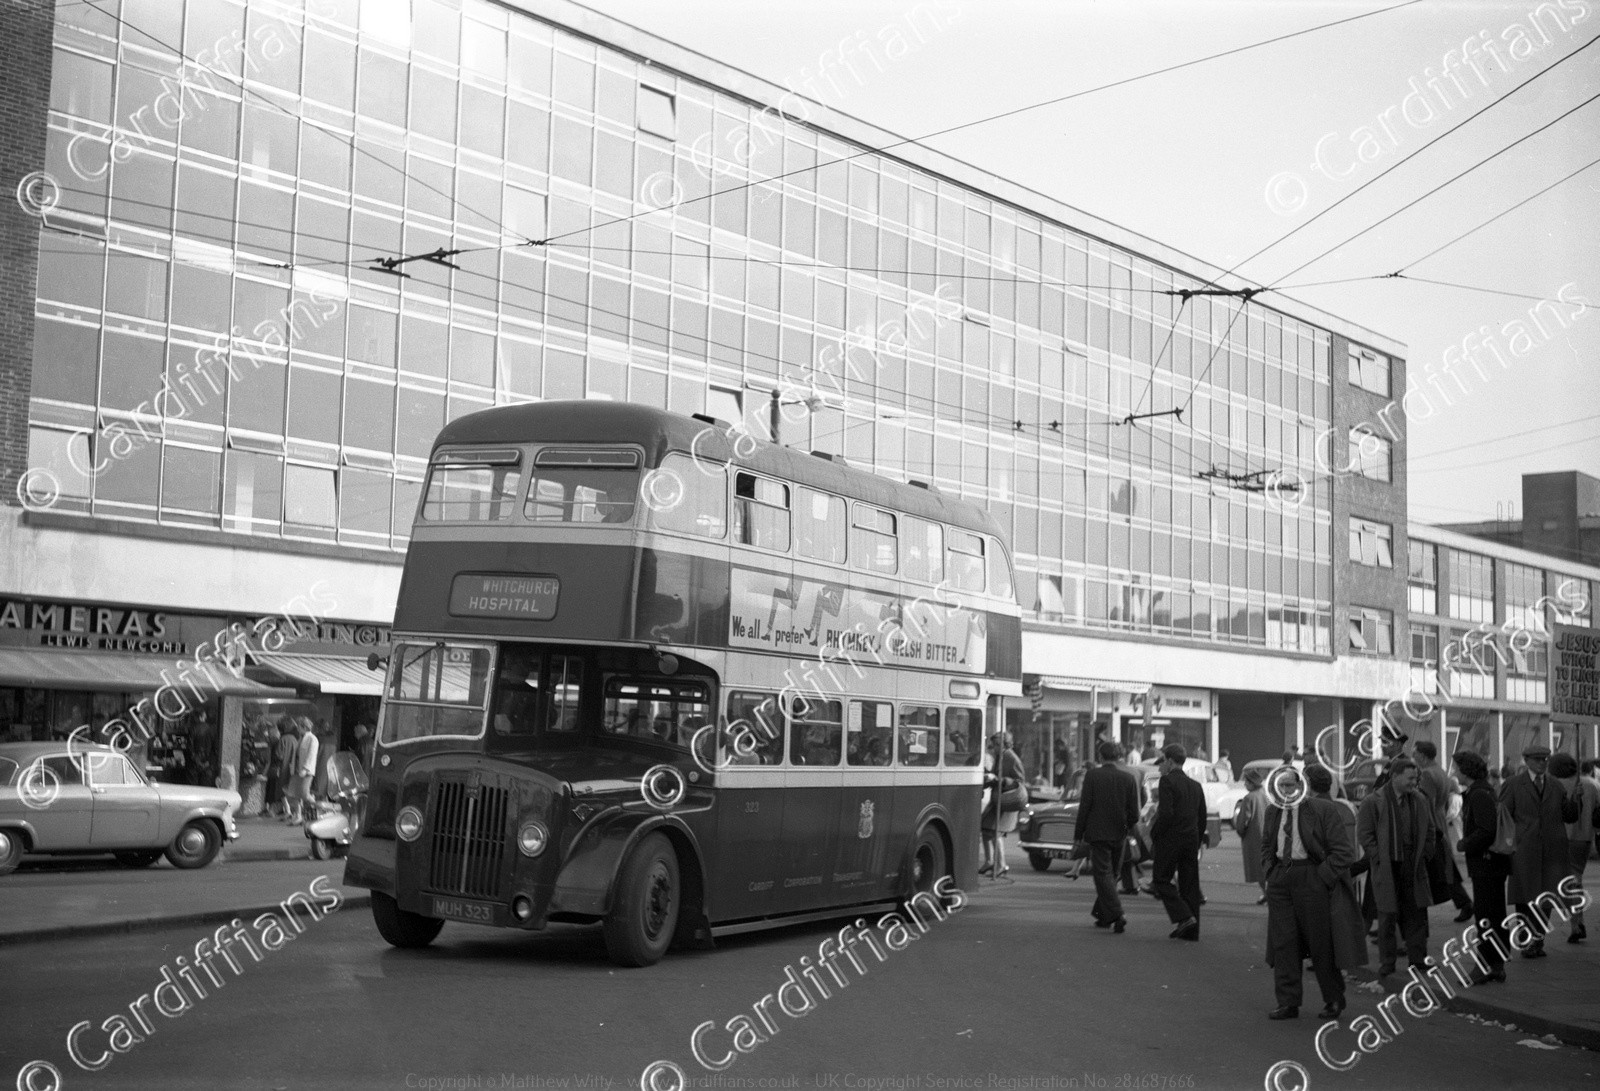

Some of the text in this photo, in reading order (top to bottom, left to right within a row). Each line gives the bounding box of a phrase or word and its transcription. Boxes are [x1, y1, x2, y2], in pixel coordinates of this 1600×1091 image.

[482, 579, 559, 595] WHITCHURCH
[468, 596, 539, 612] HOSPITAL
[47, 634, 93, 649] LEWIS
[732, 615, 746, 638] We
[747, 618, 761, 639] all
[774, 625, 804, 647] prefer
[892, 638, 922, 659] WELSH
[926, 642, 957, 663] BITTER
[1555, 632, 1600, 655] JESUS
[1561, 651, 1597, 670] WHOM
[1555, 665, 1570, 681] TO
[1555, 681, 1599, 701] IS LIFE
[435, 900, 490, 920] MUH 323
